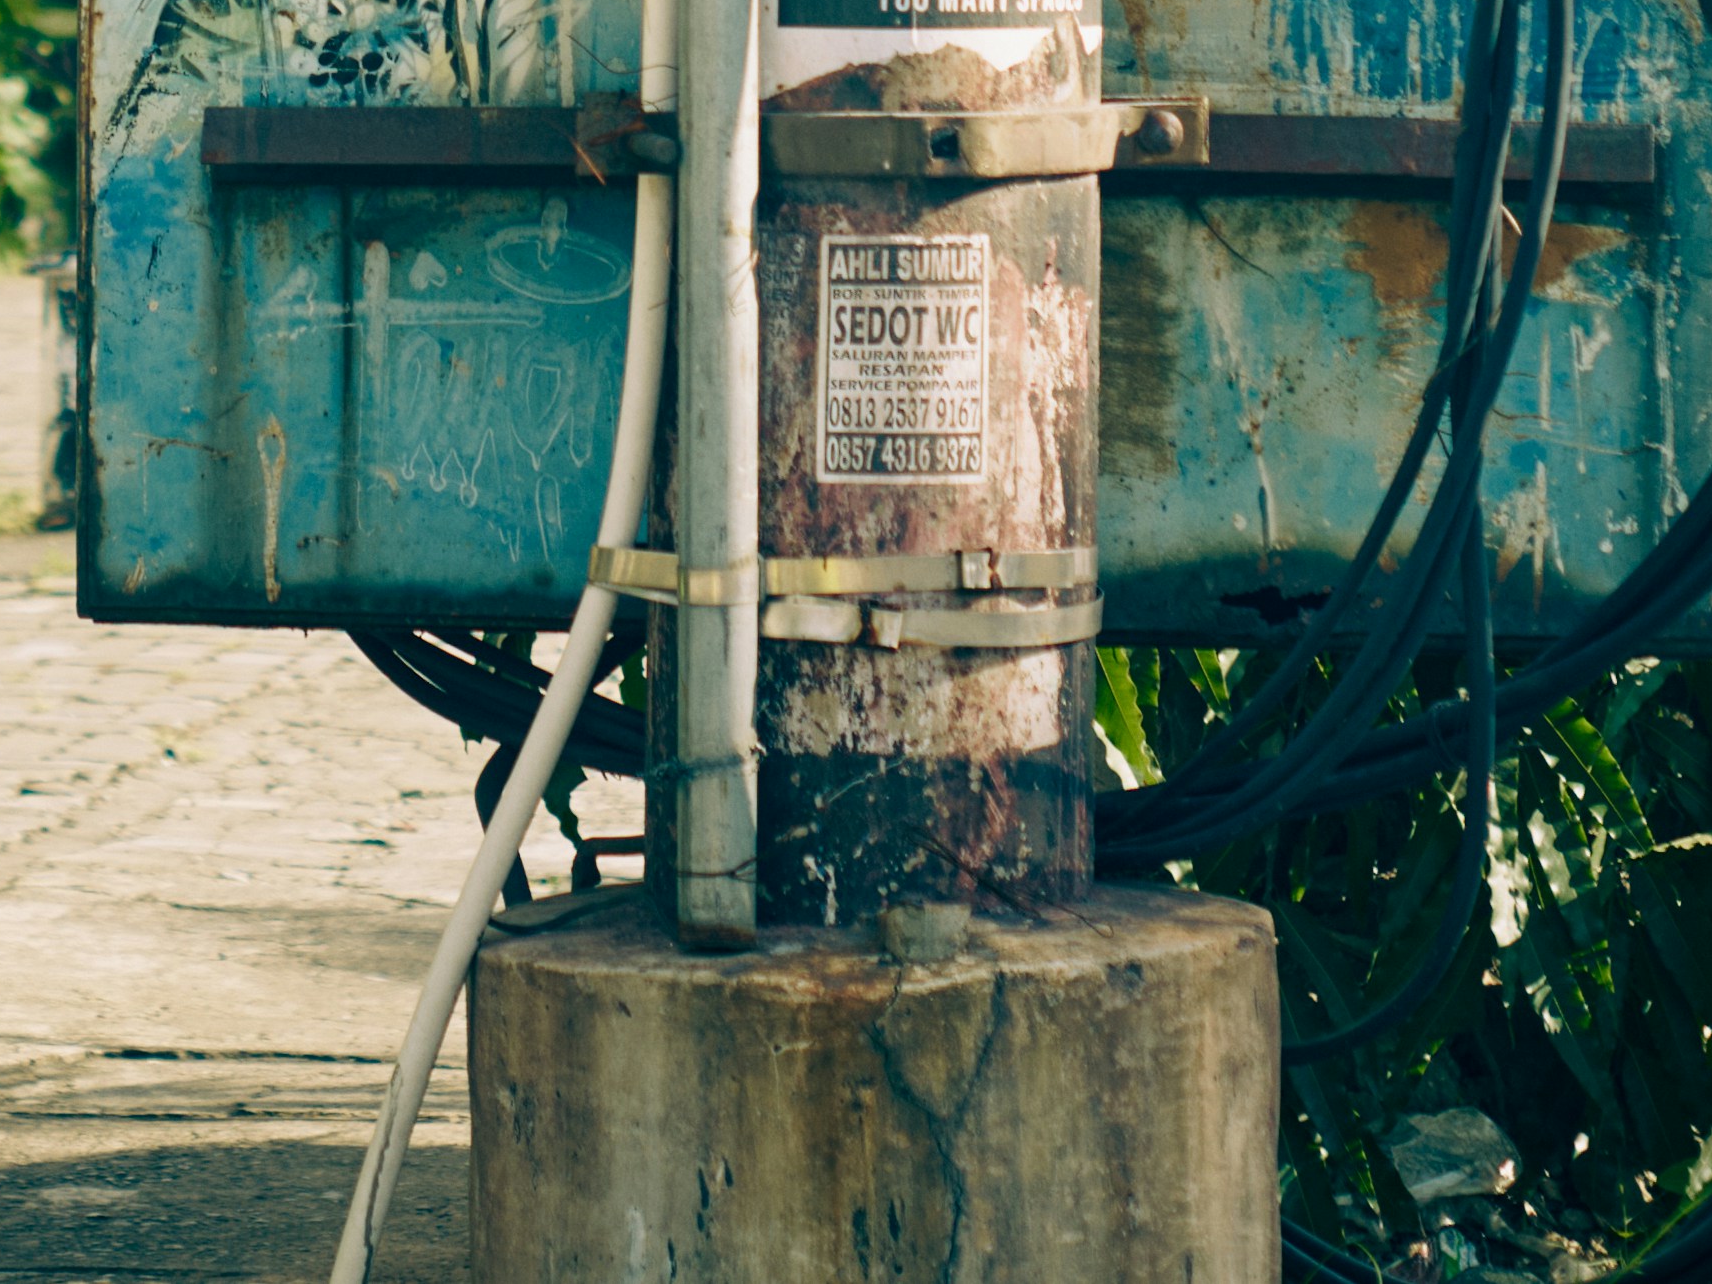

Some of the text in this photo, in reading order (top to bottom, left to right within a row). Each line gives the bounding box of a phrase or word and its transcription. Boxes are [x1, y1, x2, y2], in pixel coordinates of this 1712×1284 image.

[830, 247, 983, 281] AHLI SUMUR
[832, 288, 980, 300] BOR SUNTIK TIMBA
[833, 305, 979, 346] SEDOT WC
[831, 350, 976, 361] SALURAN MAMPET
[859, 364, 944, 376] RESAPAN
[830, 380, 978, 391] SERVICE POMPA AIR
[829, 396, 979, 428] 0813 2537 9167
[826, 435, 981, 472] 0857 4316 9373
